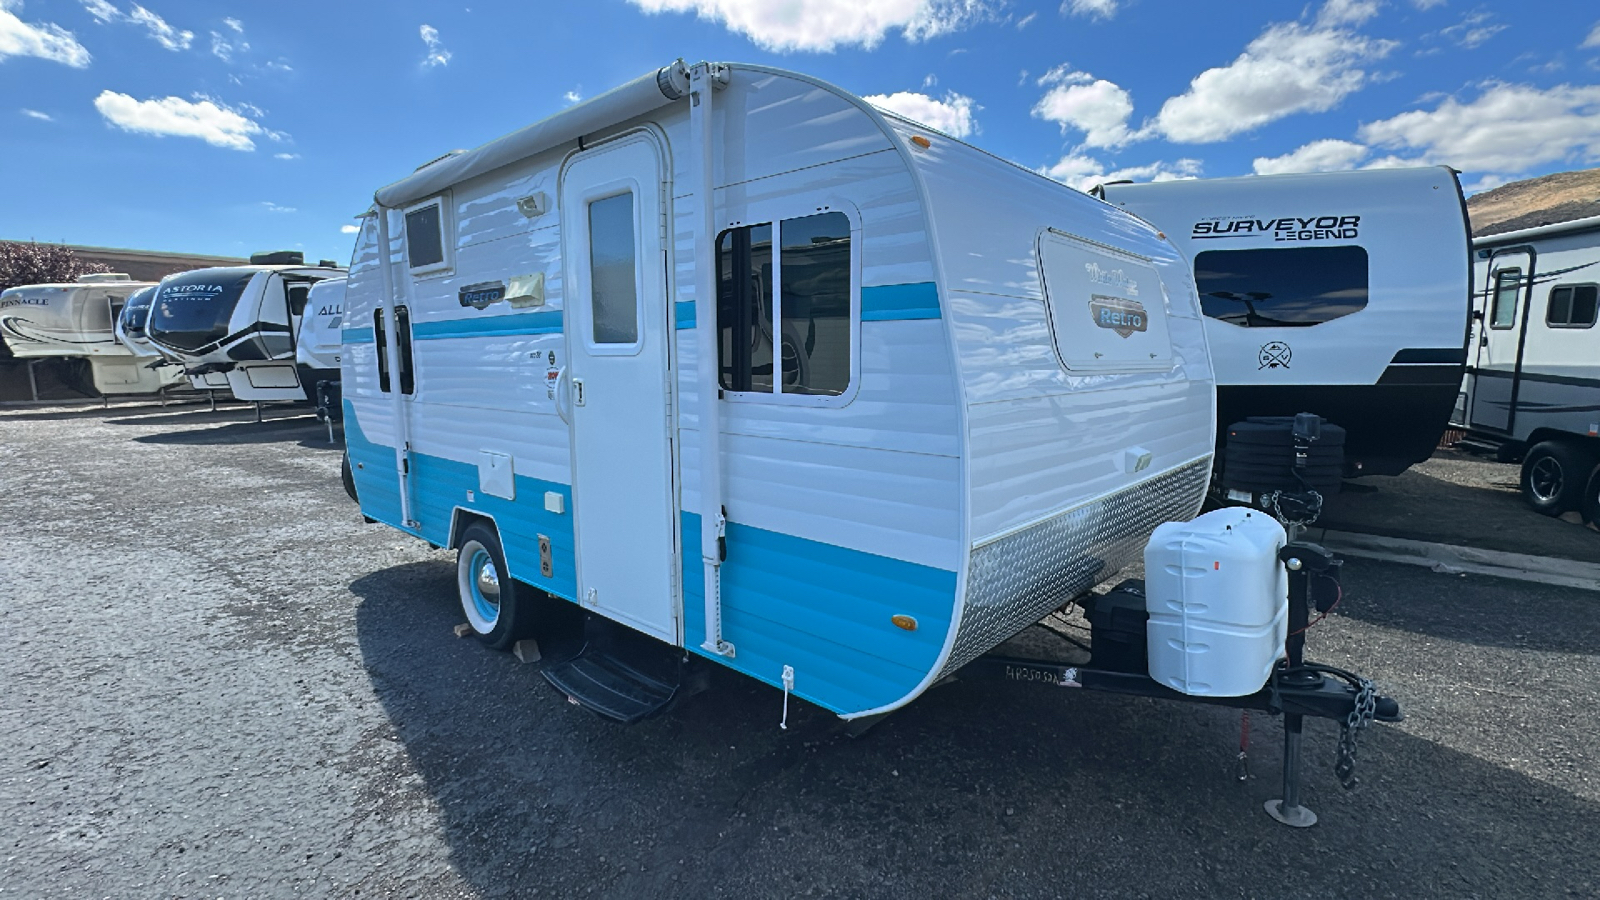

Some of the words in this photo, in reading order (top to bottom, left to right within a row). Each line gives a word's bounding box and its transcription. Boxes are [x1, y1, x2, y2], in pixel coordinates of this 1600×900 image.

[1192, 216, 1361, 234] SURVEYOR
[1274, 228, 1359, 242] LEGEND
[162, 284, 223, 294] ASTORIA
[1, 298, 49, 308] PINNACLE
[464, 291, 499, 304] Retro
[1100, 307, 1142, 328] Retro
